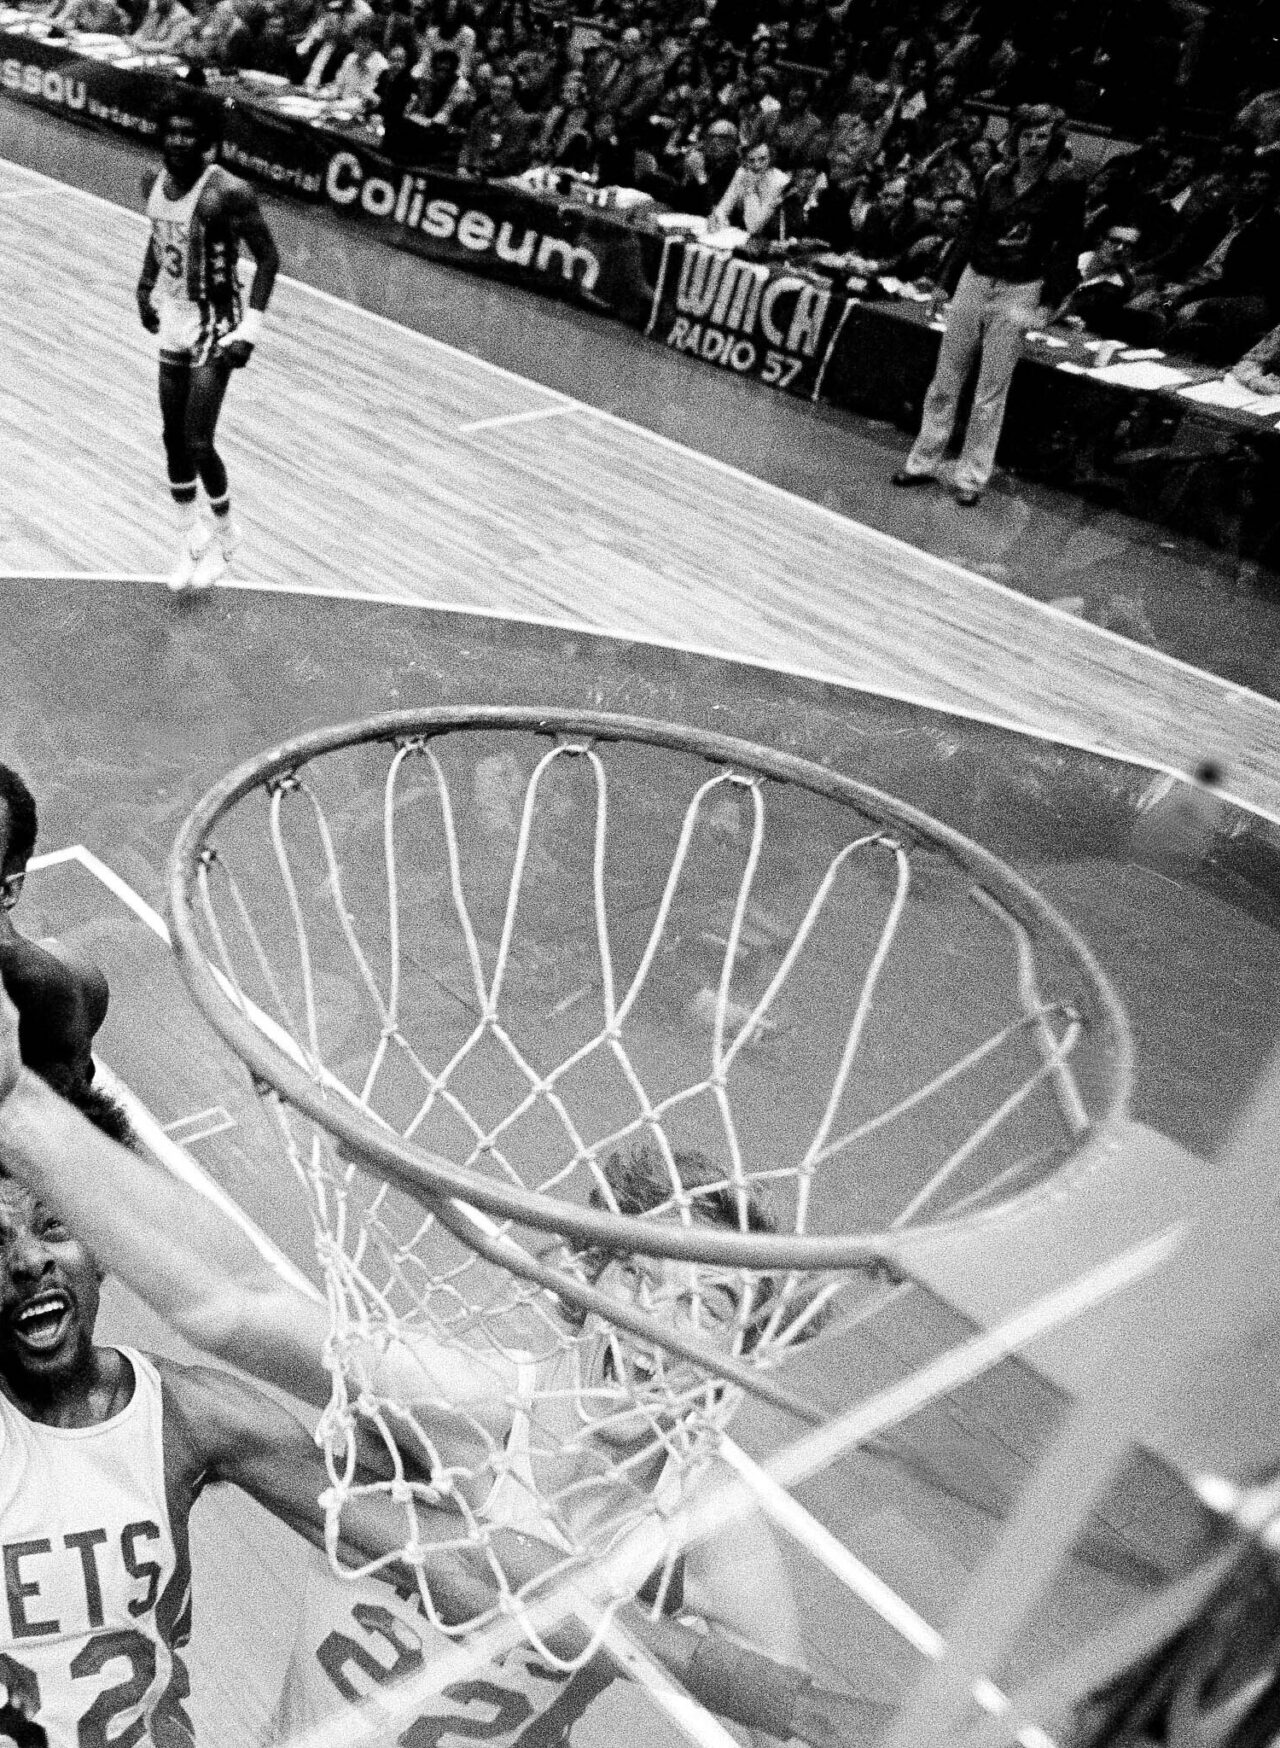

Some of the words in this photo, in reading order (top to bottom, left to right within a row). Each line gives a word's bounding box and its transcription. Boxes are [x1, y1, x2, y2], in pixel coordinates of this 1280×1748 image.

[326, 151, 601, 291] Coliseum
[667, 316, 757, 373] RADIO
[762, 349, 803, 388] 57
[676, 241, 830, 357] WMCA
